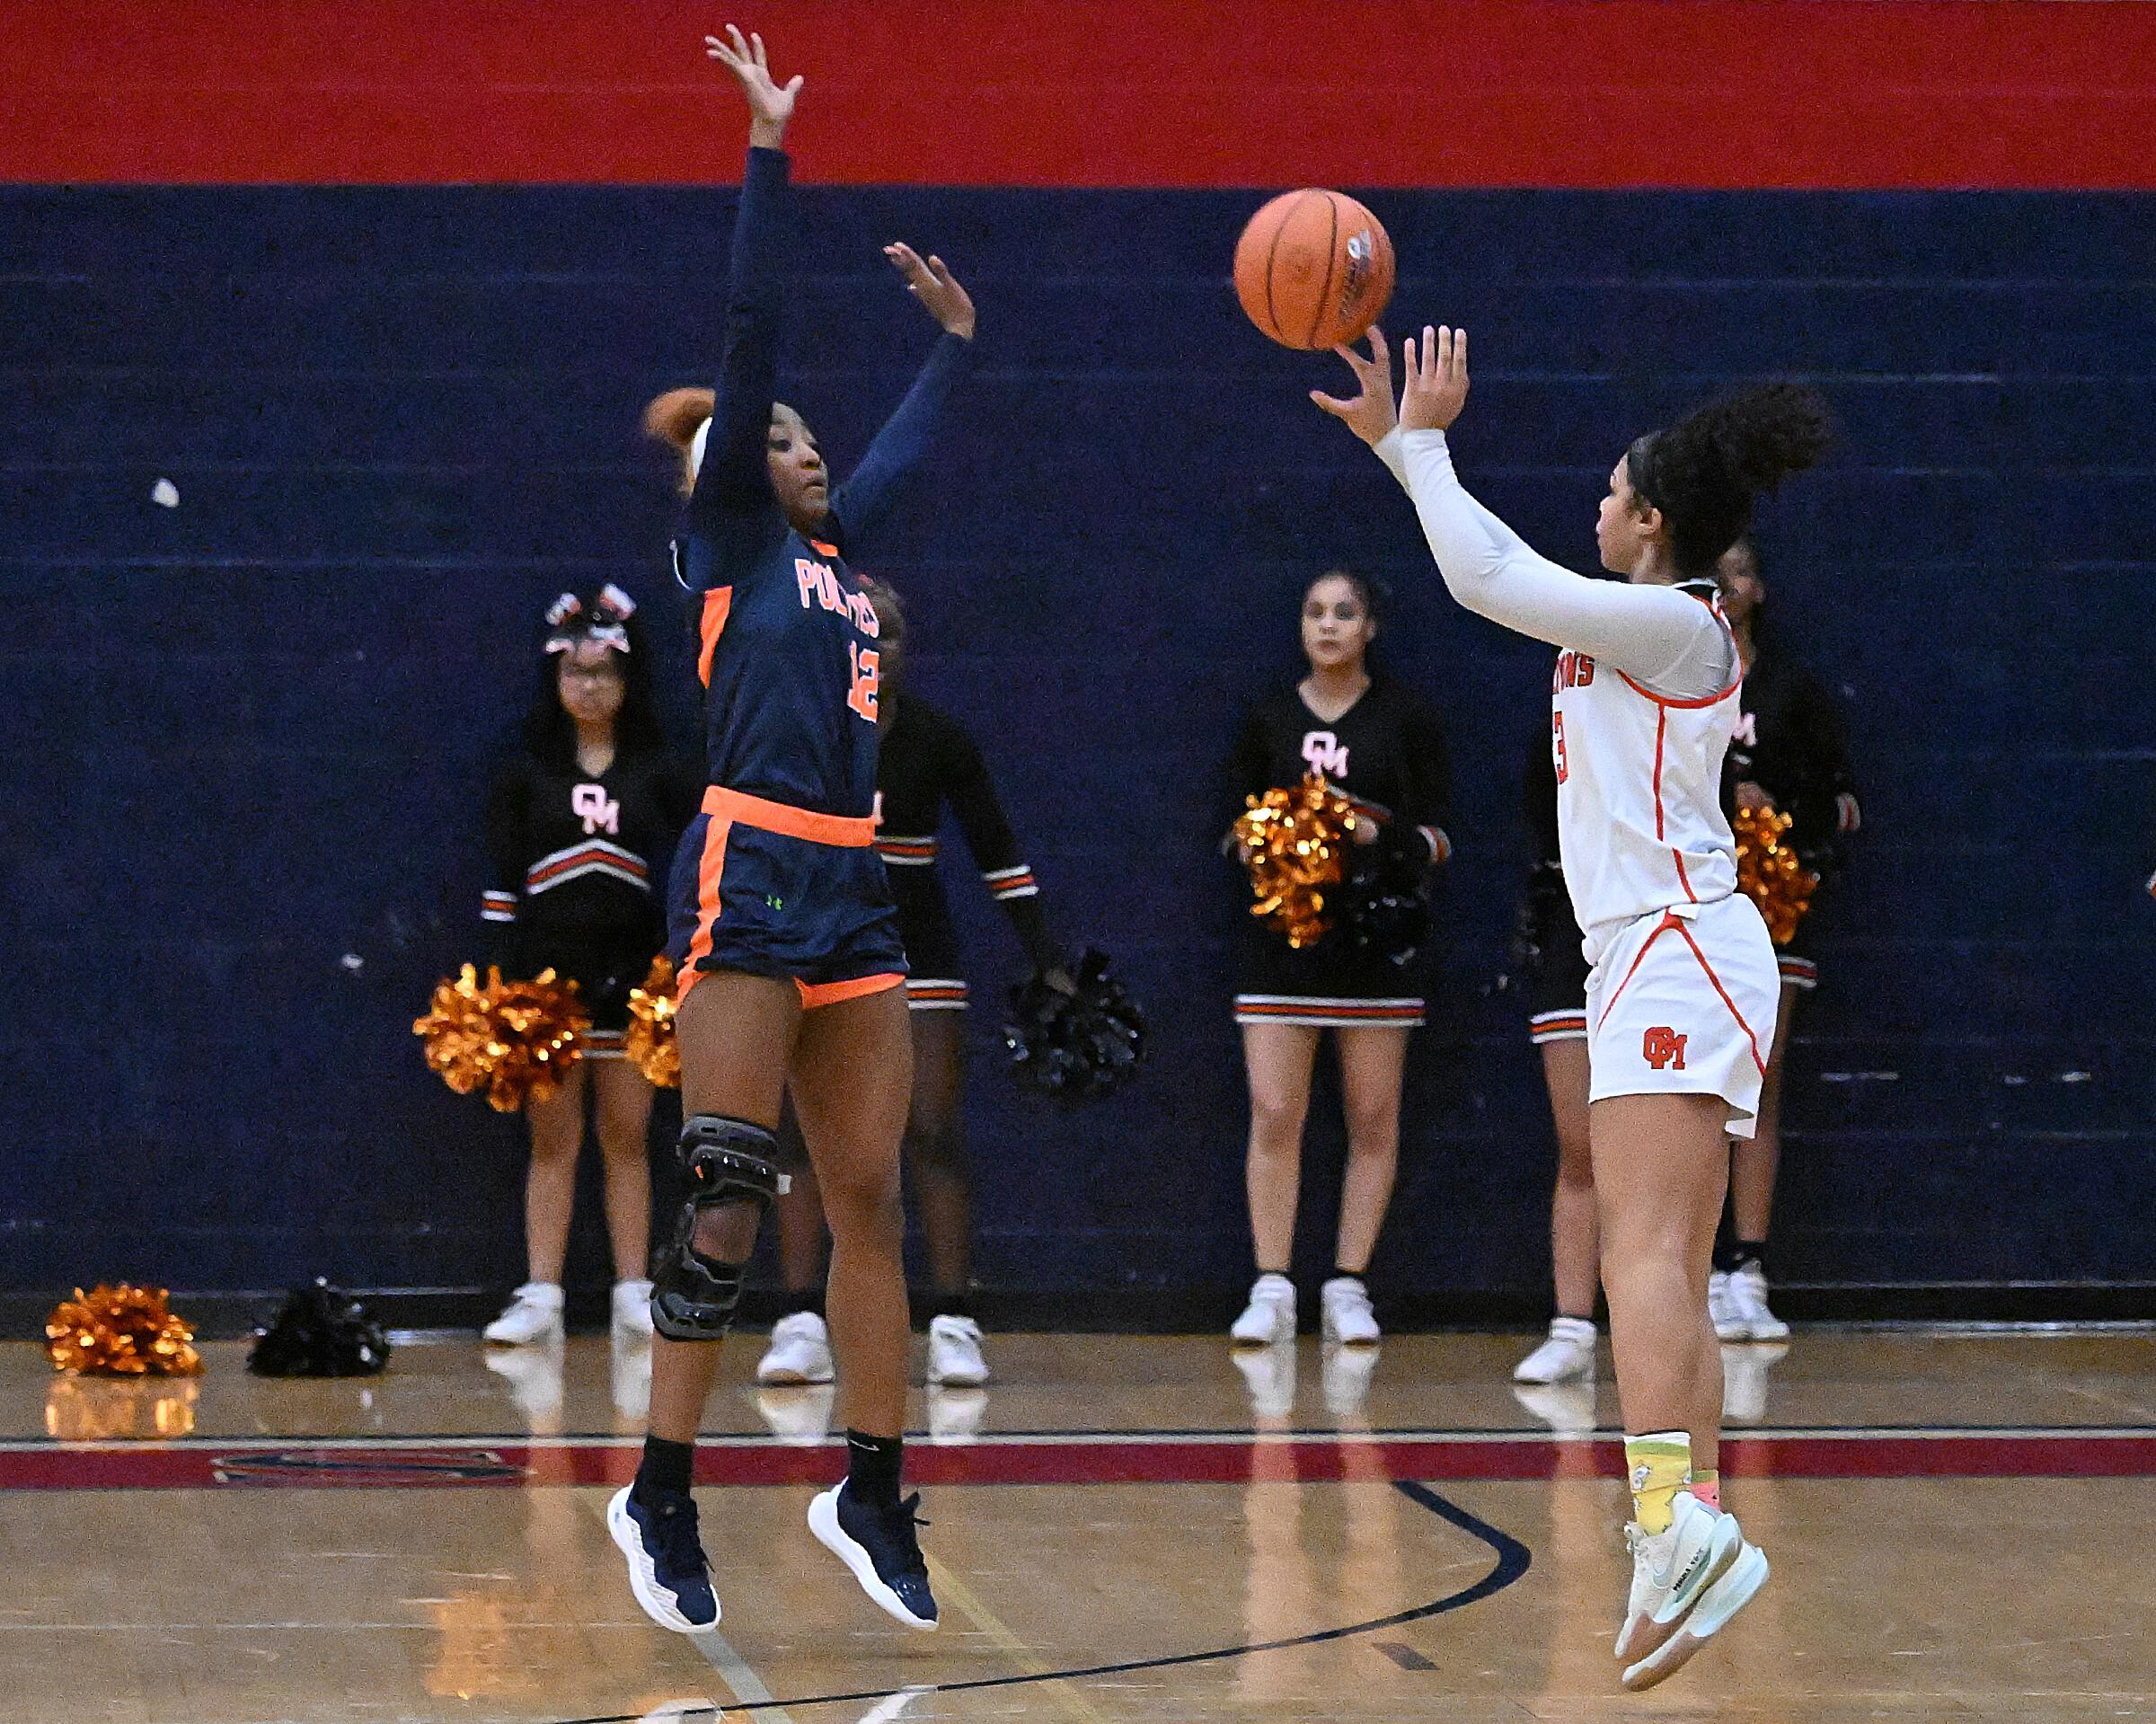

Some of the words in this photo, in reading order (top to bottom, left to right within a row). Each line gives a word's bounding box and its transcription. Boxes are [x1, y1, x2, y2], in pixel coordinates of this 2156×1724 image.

[847, 641, 879, 723] 12
[571, 782, 619, 835] OM
[1643, 1026, 1687, 1070] OM
